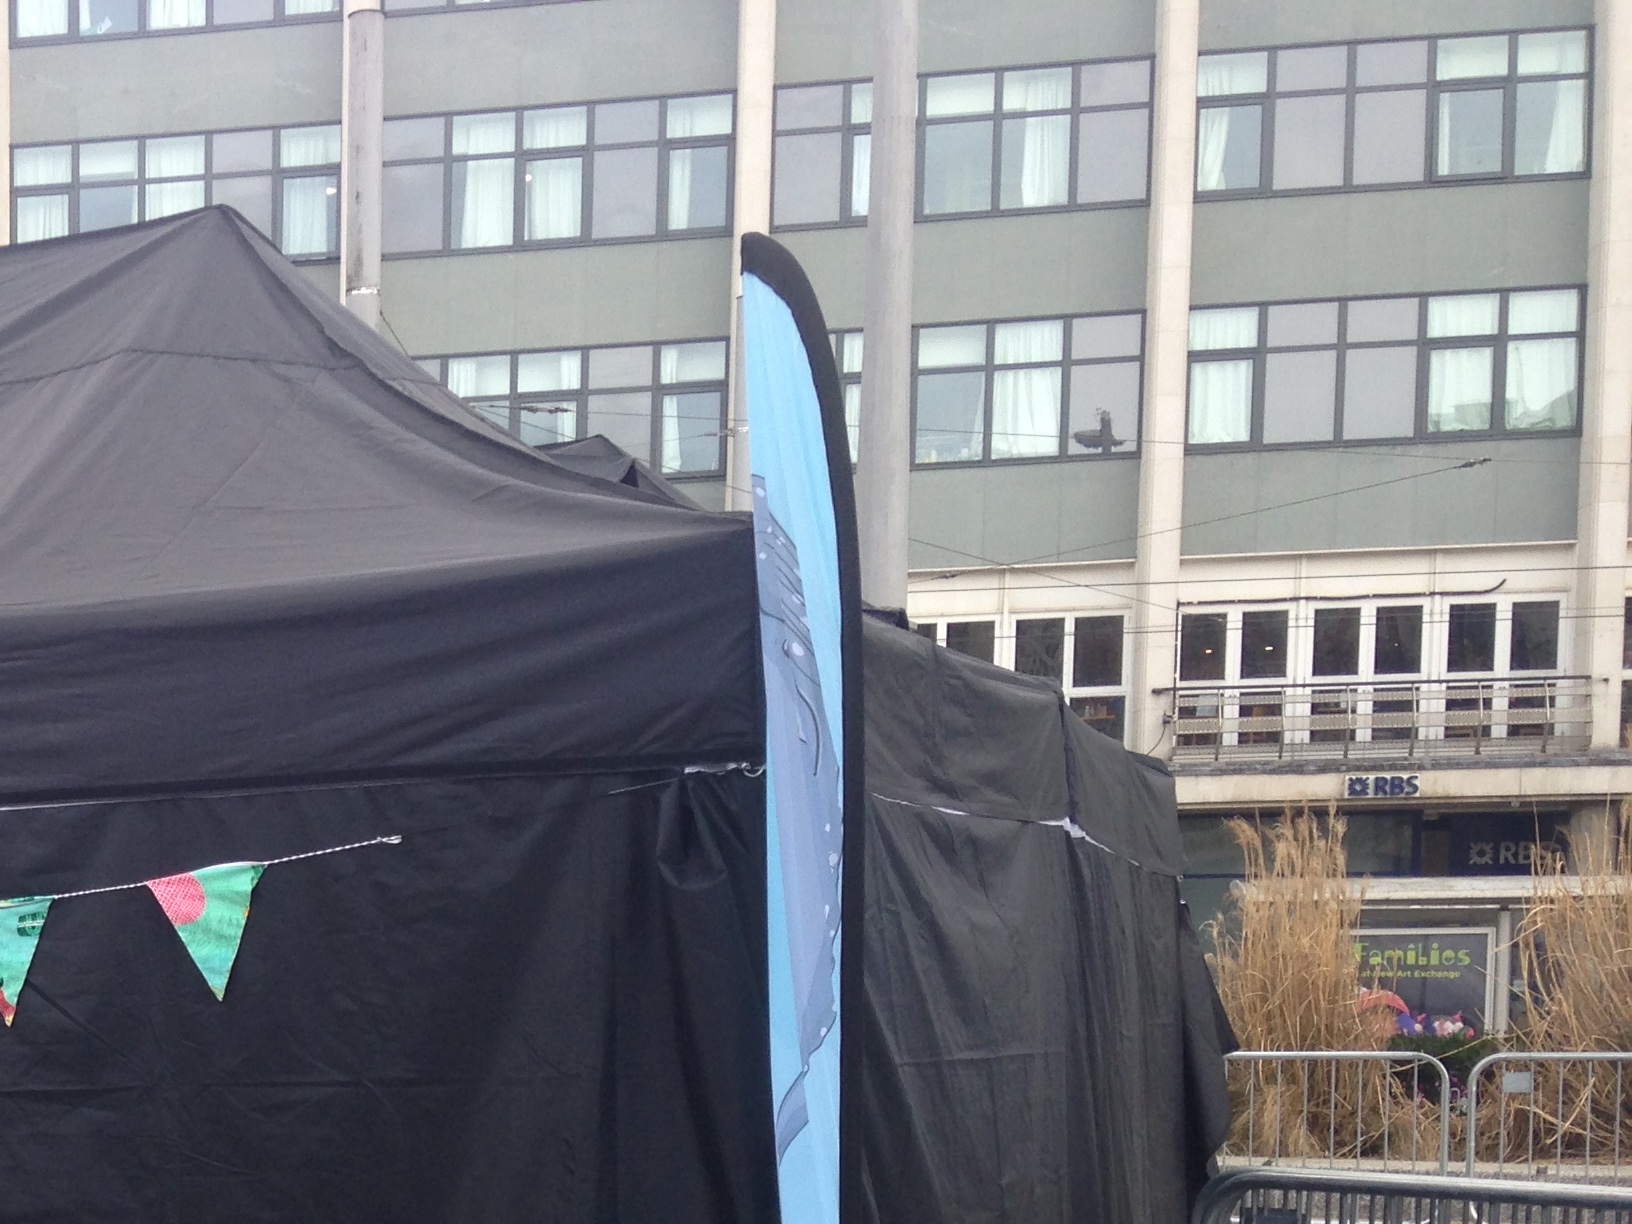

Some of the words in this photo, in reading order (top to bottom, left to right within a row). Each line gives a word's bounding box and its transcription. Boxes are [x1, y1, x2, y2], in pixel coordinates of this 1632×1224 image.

[1374, 775, 1419, 796] RBS
[1397, 969, 1411, 978] Art
[1414, 969, 1461, 979] Exchange
